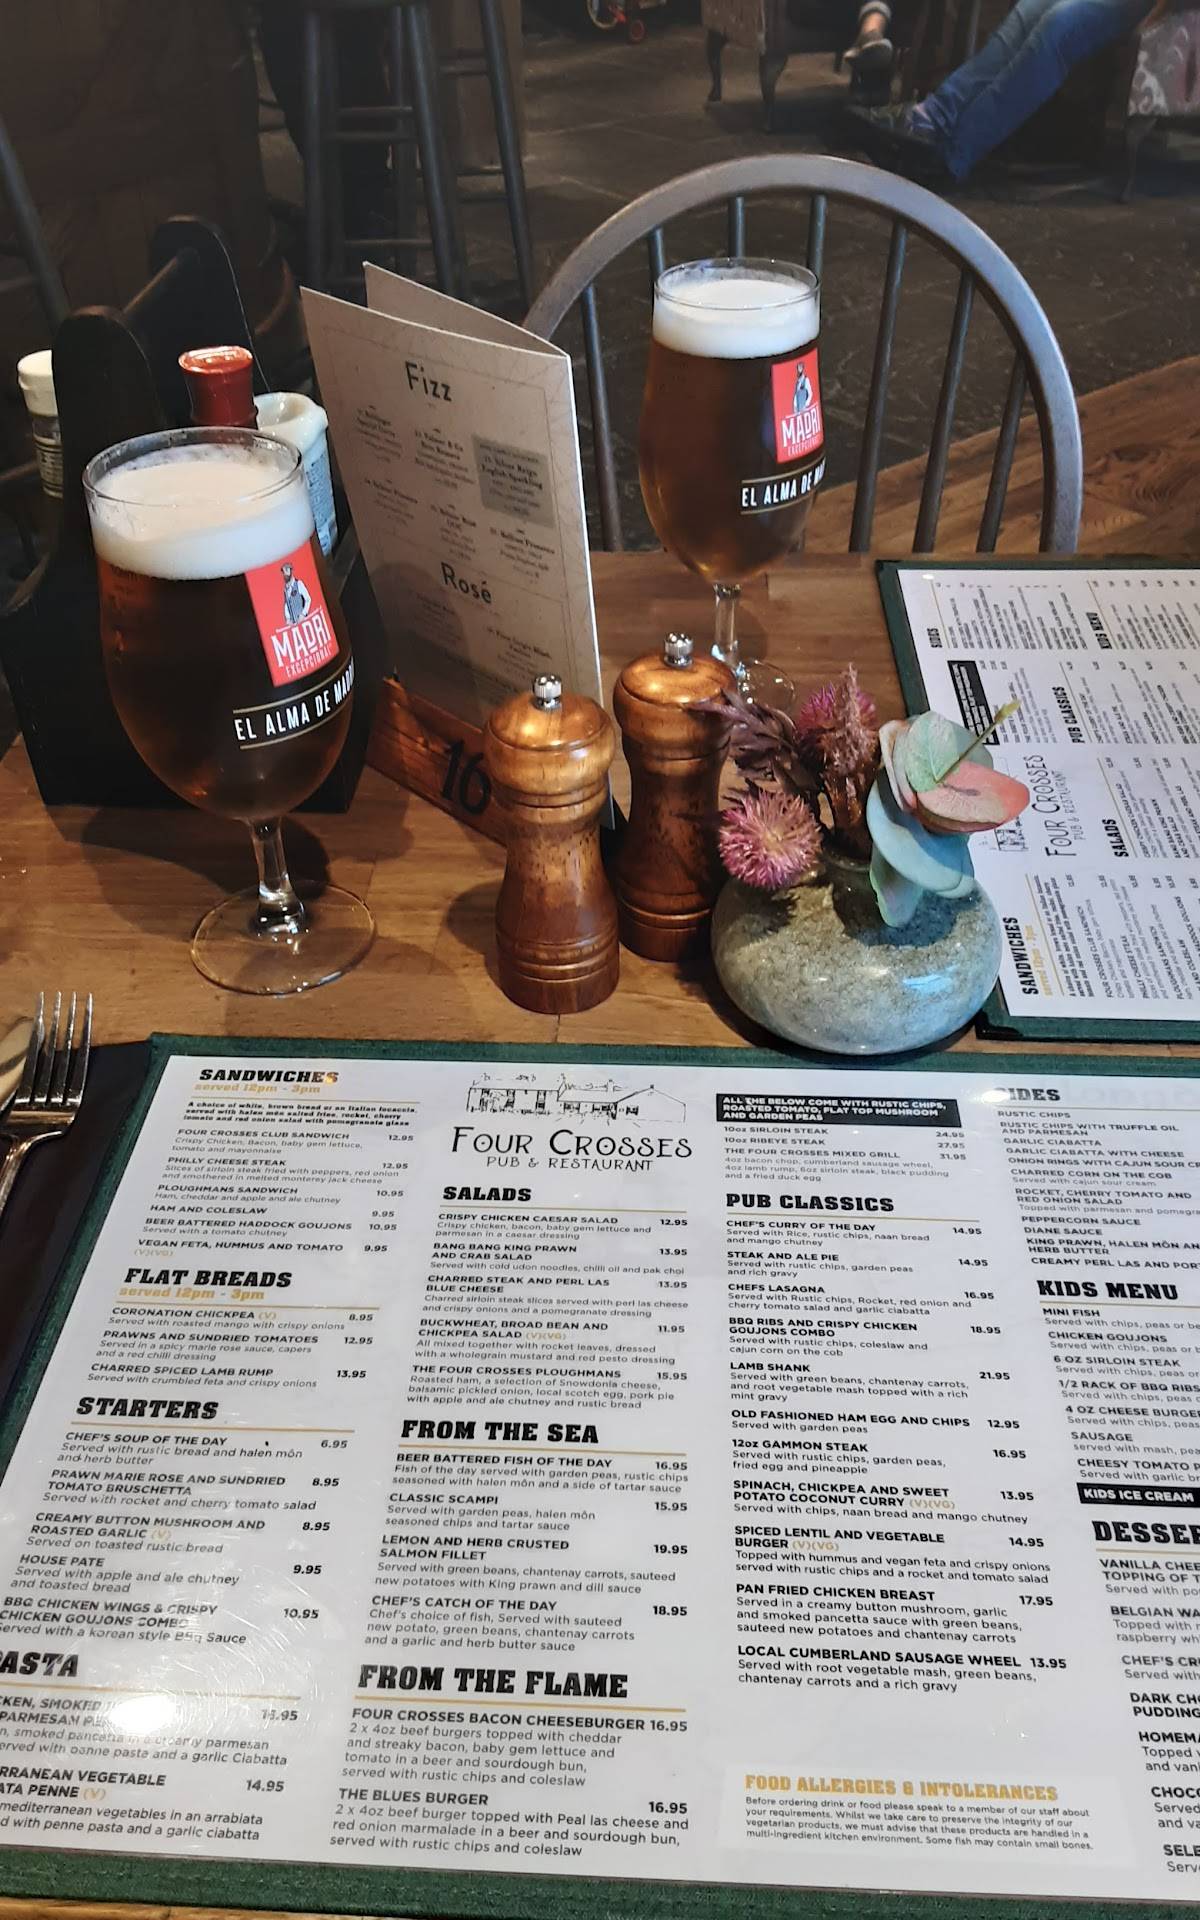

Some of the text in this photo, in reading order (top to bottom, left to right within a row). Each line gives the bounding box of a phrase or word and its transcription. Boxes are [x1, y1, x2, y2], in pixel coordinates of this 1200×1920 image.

[405, 361, 452, 403] Fizz
[742, 487, 757, 507] EL
[764, 479, 797, 505] ALMA
[801, 471, 812, 494] DE
[441, 562, 493, 604] Rosé
[1085, 612, 1112, 649] KIDS MENU
[286, 648, 331, 677] EXCEPCIONAL
[234, 718, 257, 741] EL
[266, 702, 310, 736] ALMA
[315, 689, 331, 718] DE
[1051, 686, 1085, 743] PUB CLASSICS
[442, 740, 491, 816] 16
[1022, 754, 1077, 857] FOUR CROSSES
[1069, 824, 1086, 840] PUB
[1101, 818, 1129, 857] SALADS
[1002, 917, 1039, 994] SANDWICHES
[199, 1068, 339, 1083] SANDWICHES
[746, 1097, 766, 1105] THE
[768, 1098, 805, 1106] BELOW
[807, 1098, 838, 1106] COME
[840, 1099, 869, 1107] WITH
[870, 1100, 909, 1108] RUSTIC
[911, 1101, 946, 1110] CHIPS,
[209, 1129, 258, 1137] CROSSES
[291, 1131, 350, 1139] SANDWICH
[452, 1126, 693, 1159] FOUR CROSSES
[486, 1155, 653, 1172] PUB & RESTAURANT
[442, 1186, 531, 1202] SALADS
[725, 1193, 894, 1212] PUB CLASSICS
[150, 1204, 394, 1218] HAM AND COLESLAW 9.95
[123, 1267, 292, 1288] FLAT BREADS
[119, 1287, 171, 1297] served
[175, 1287, 215, 1300] 12pm
[231, 1288, 265, 1301] 3pm
[1036, 1279, 1178, 1300] KIDS MENU
[1047, 1331, 1167, 1342] CHICKEN GOUJONS
[90, 1362, 366, 1378] CHARRED SPICED LAMB RUMP 13.95
[412, 1364, 687, 1380] THE FOUR CROSSES PLOUGHMANS 15.95
[730, 1361, 1010, 1380] LAMB SHANK 21.95
[75, 1396, 219, 1419] STARTERS
[400, 1419, 599, 1444] FROM THE SEA
[1083, 1488, 1194, 1502] KIDS ICE CREAM
[379, 1548, 486, 1560] SALMON FILLET
[381, 1534, 688, 1554] LEMON AND HERB CRUSTED 19.95
[19, 1553, 322, 1574] HOUSE PATE 9.95
[736, 1583, 1053, 1606] PAN FRIED CHICKEN BREAST 17.95
[0, 1650, 78, 1677] ASTA
[737, 1644, 1066, 1669] LOCAL CUMBERLAND SAUSAGE WHEEL 13.95
[357, 1664, 628, 1698] FROM THE FLAME
[745, 1775, 1057, 1802] FOOD ALLERGIES & INTOLERANCES
[338, 1787, 687, 1814] THE BLUES BURGER 16.95
[745, 1796, 776, 1805] Before
[778, 1797, 818, 1809] ordering
[820, 1799, 845, 1808] drink
[859, 1800, 881, 1809] food
[883, 1801, 914, 1811] please
[916, 1803, 944, 1812] speak
[945, 1804, 956, 1812] to
[966, 1804, 1005, 1814] member
[1007, 1806, 1017, 1815] of
[1020, 1807, 1036, 1815] our
[1038, 1807, 1059, 1816] staff
[1061, 1808, 1089, 1817] about
[332, 1818, 680, 1847] red onion marmalade in a beer and sourdough bun,
